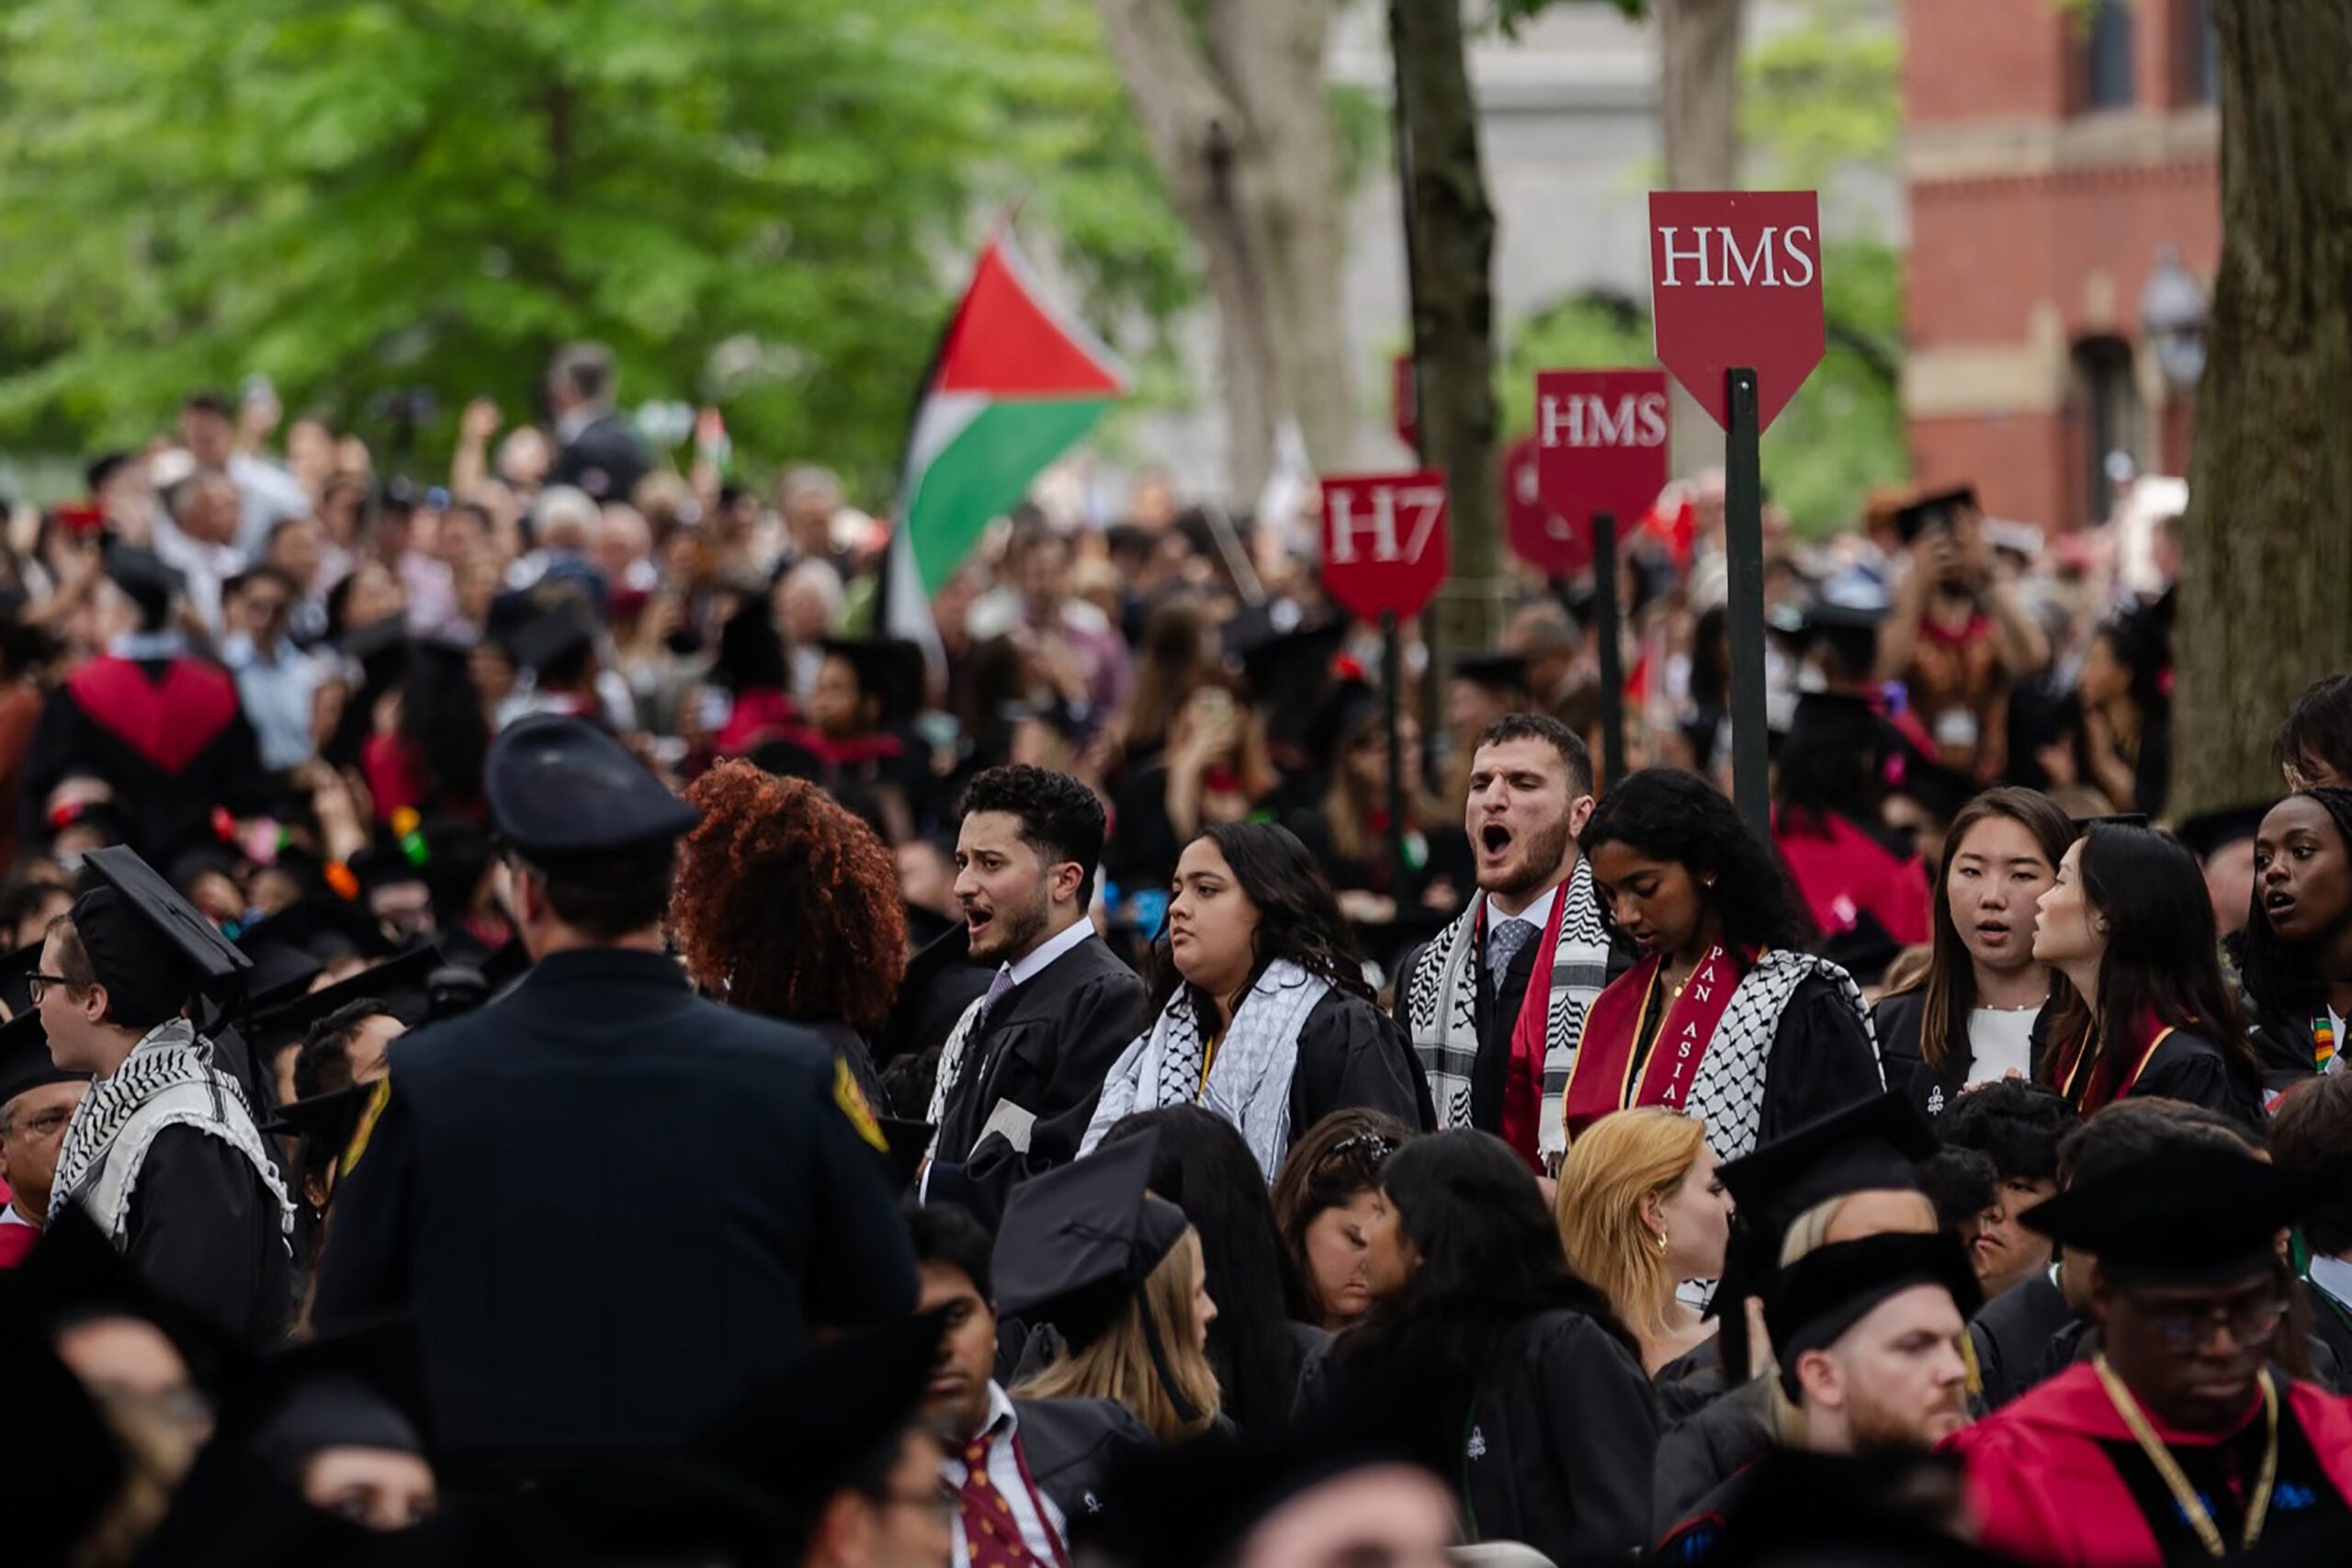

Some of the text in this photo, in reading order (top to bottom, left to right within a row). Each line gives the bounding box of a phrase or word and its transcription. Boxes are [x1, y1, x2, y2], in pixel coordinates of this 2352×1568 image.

[1658, 226, 1814, 288] HMS
[1541, 393, 1667, 447] HMS
[1328, 485, 1446, 565] H7
[1695, 946, 1723, 1002] PAN
